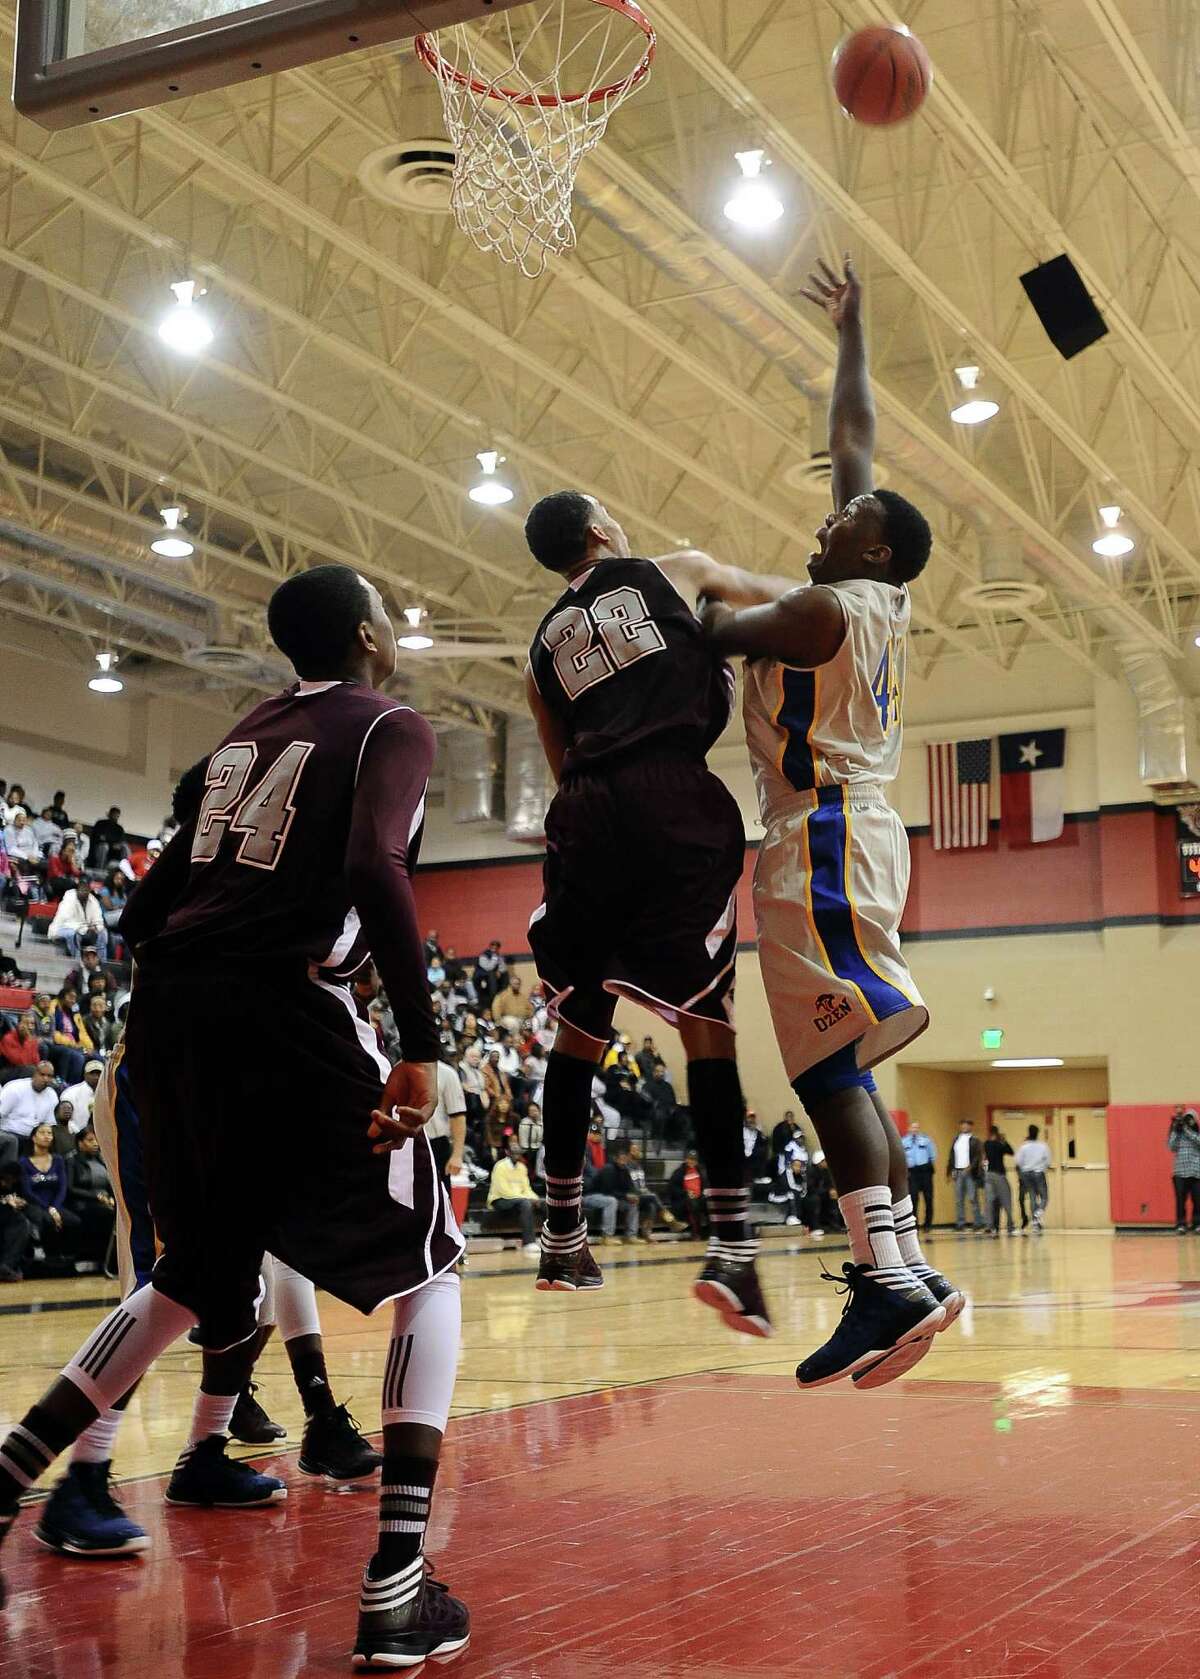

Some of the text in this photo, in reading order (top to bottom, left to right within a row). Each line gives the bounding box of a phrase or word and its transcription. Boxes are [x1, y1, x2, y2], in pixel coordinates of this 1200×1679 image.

[541, 585, 668, 701] 22
[190, 740, 316, 871] 24
[813, 996, 852, 1033] OZEN
